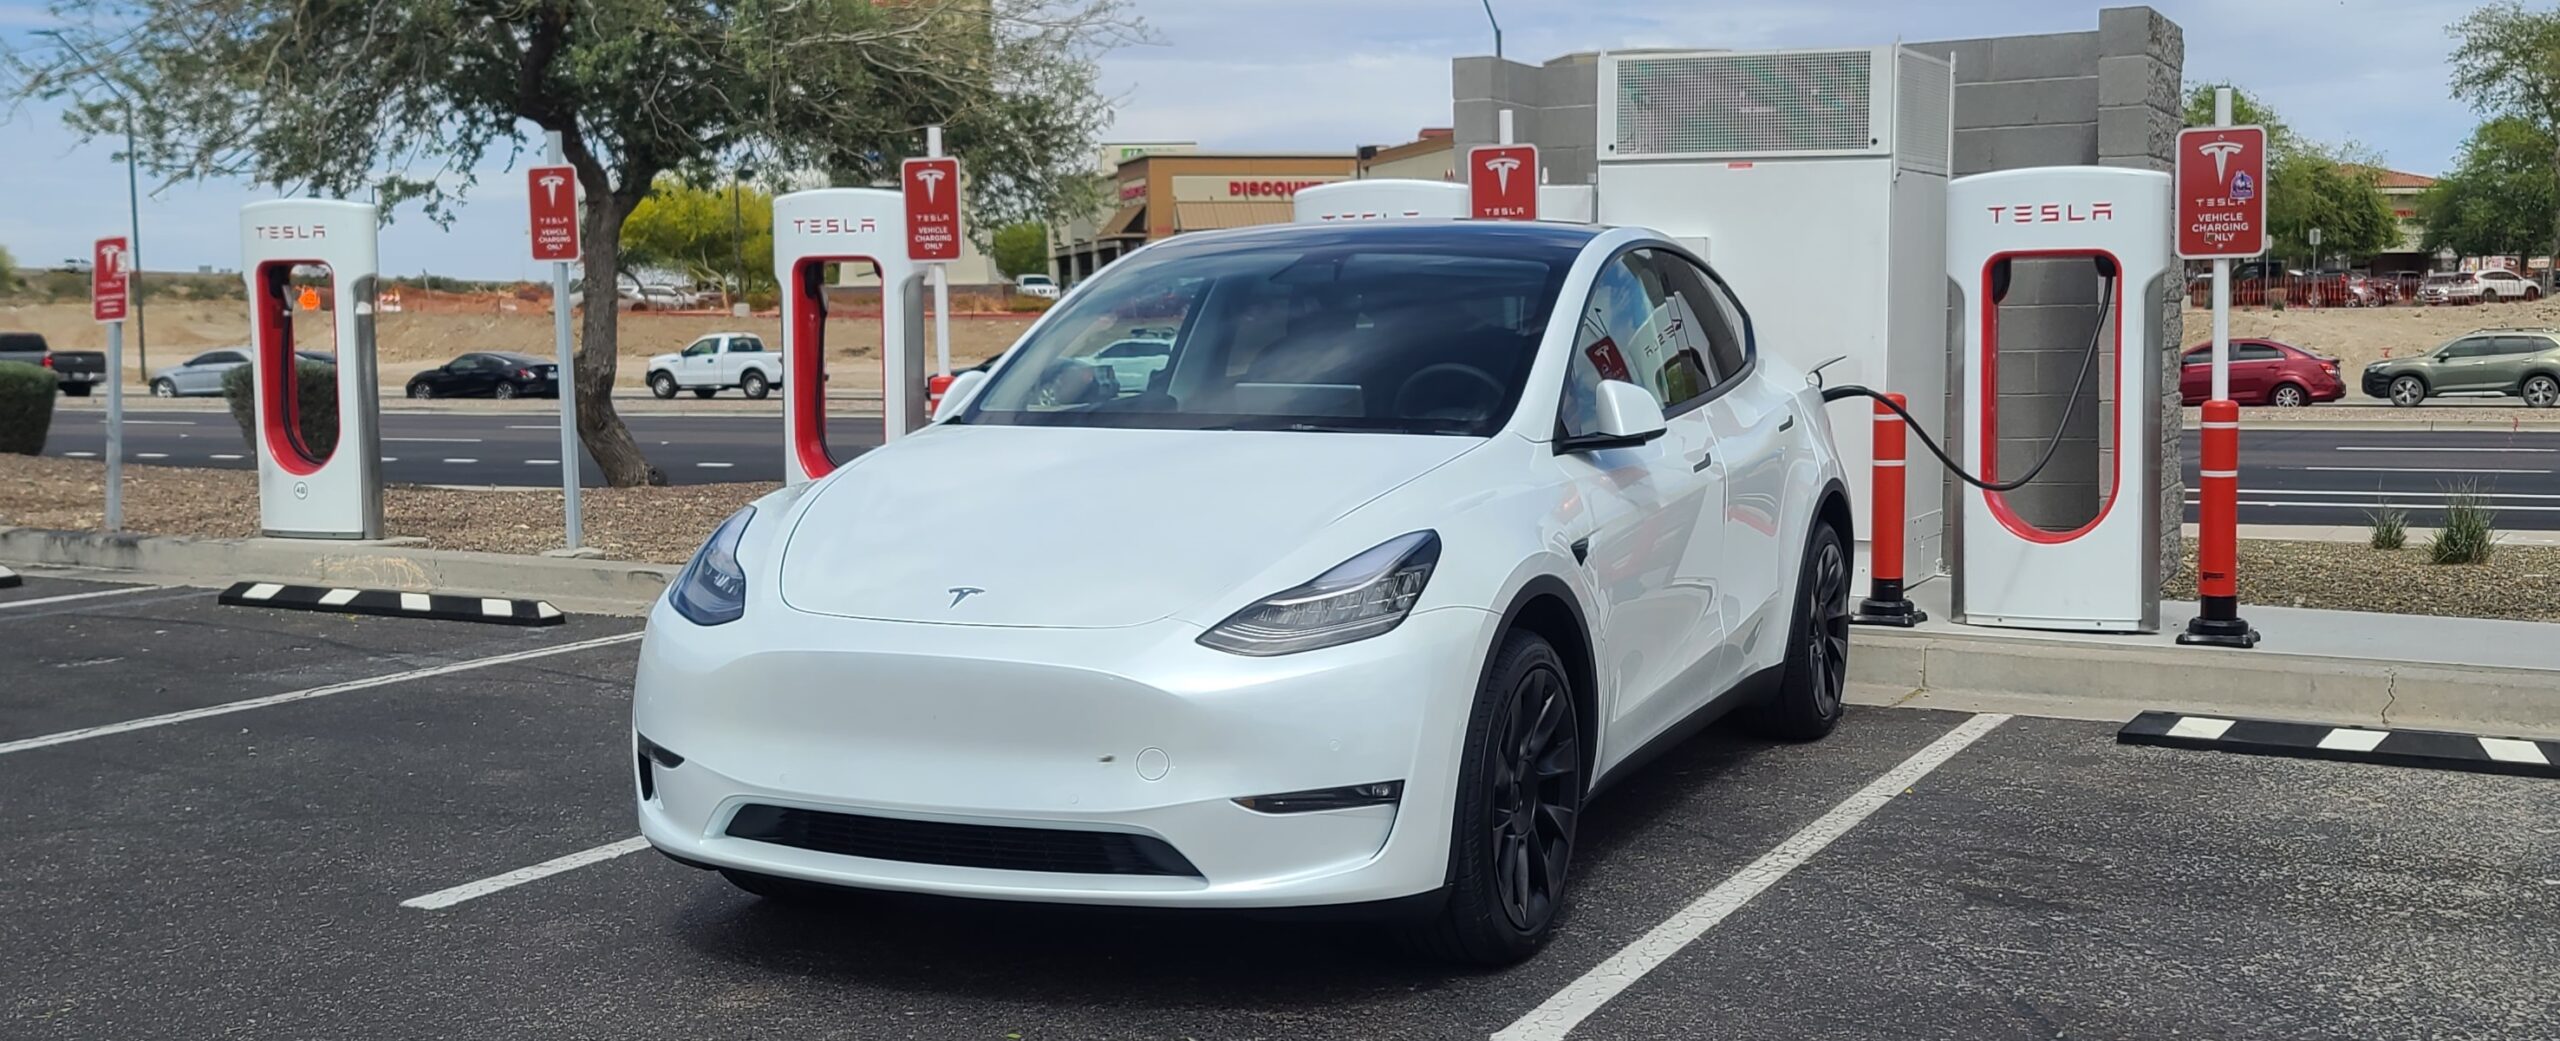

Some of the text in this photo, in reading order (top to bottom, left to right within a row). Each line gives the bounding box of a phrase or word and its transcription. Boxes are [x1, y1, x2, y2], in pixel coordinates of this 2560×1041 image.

[1484, 206, 1524, 216] TESLA
[1986, 203, 2113, 224] TESLA
[915, 213, 949, 222] TESLA
[2197, 212, 2244, 222] VEHICLE
[794, 219, 875, 233] TESLA
[918, 226, 948, 234] VEHICLE
[2191, 222, 2250, 233] CHARGING
[255, 224, 326, 239] TESLA
[914, 234, 952, 242] CHARGING
[2205, 232, 2236, 243] NLY
[924, 242, 943, 250] ONLY
